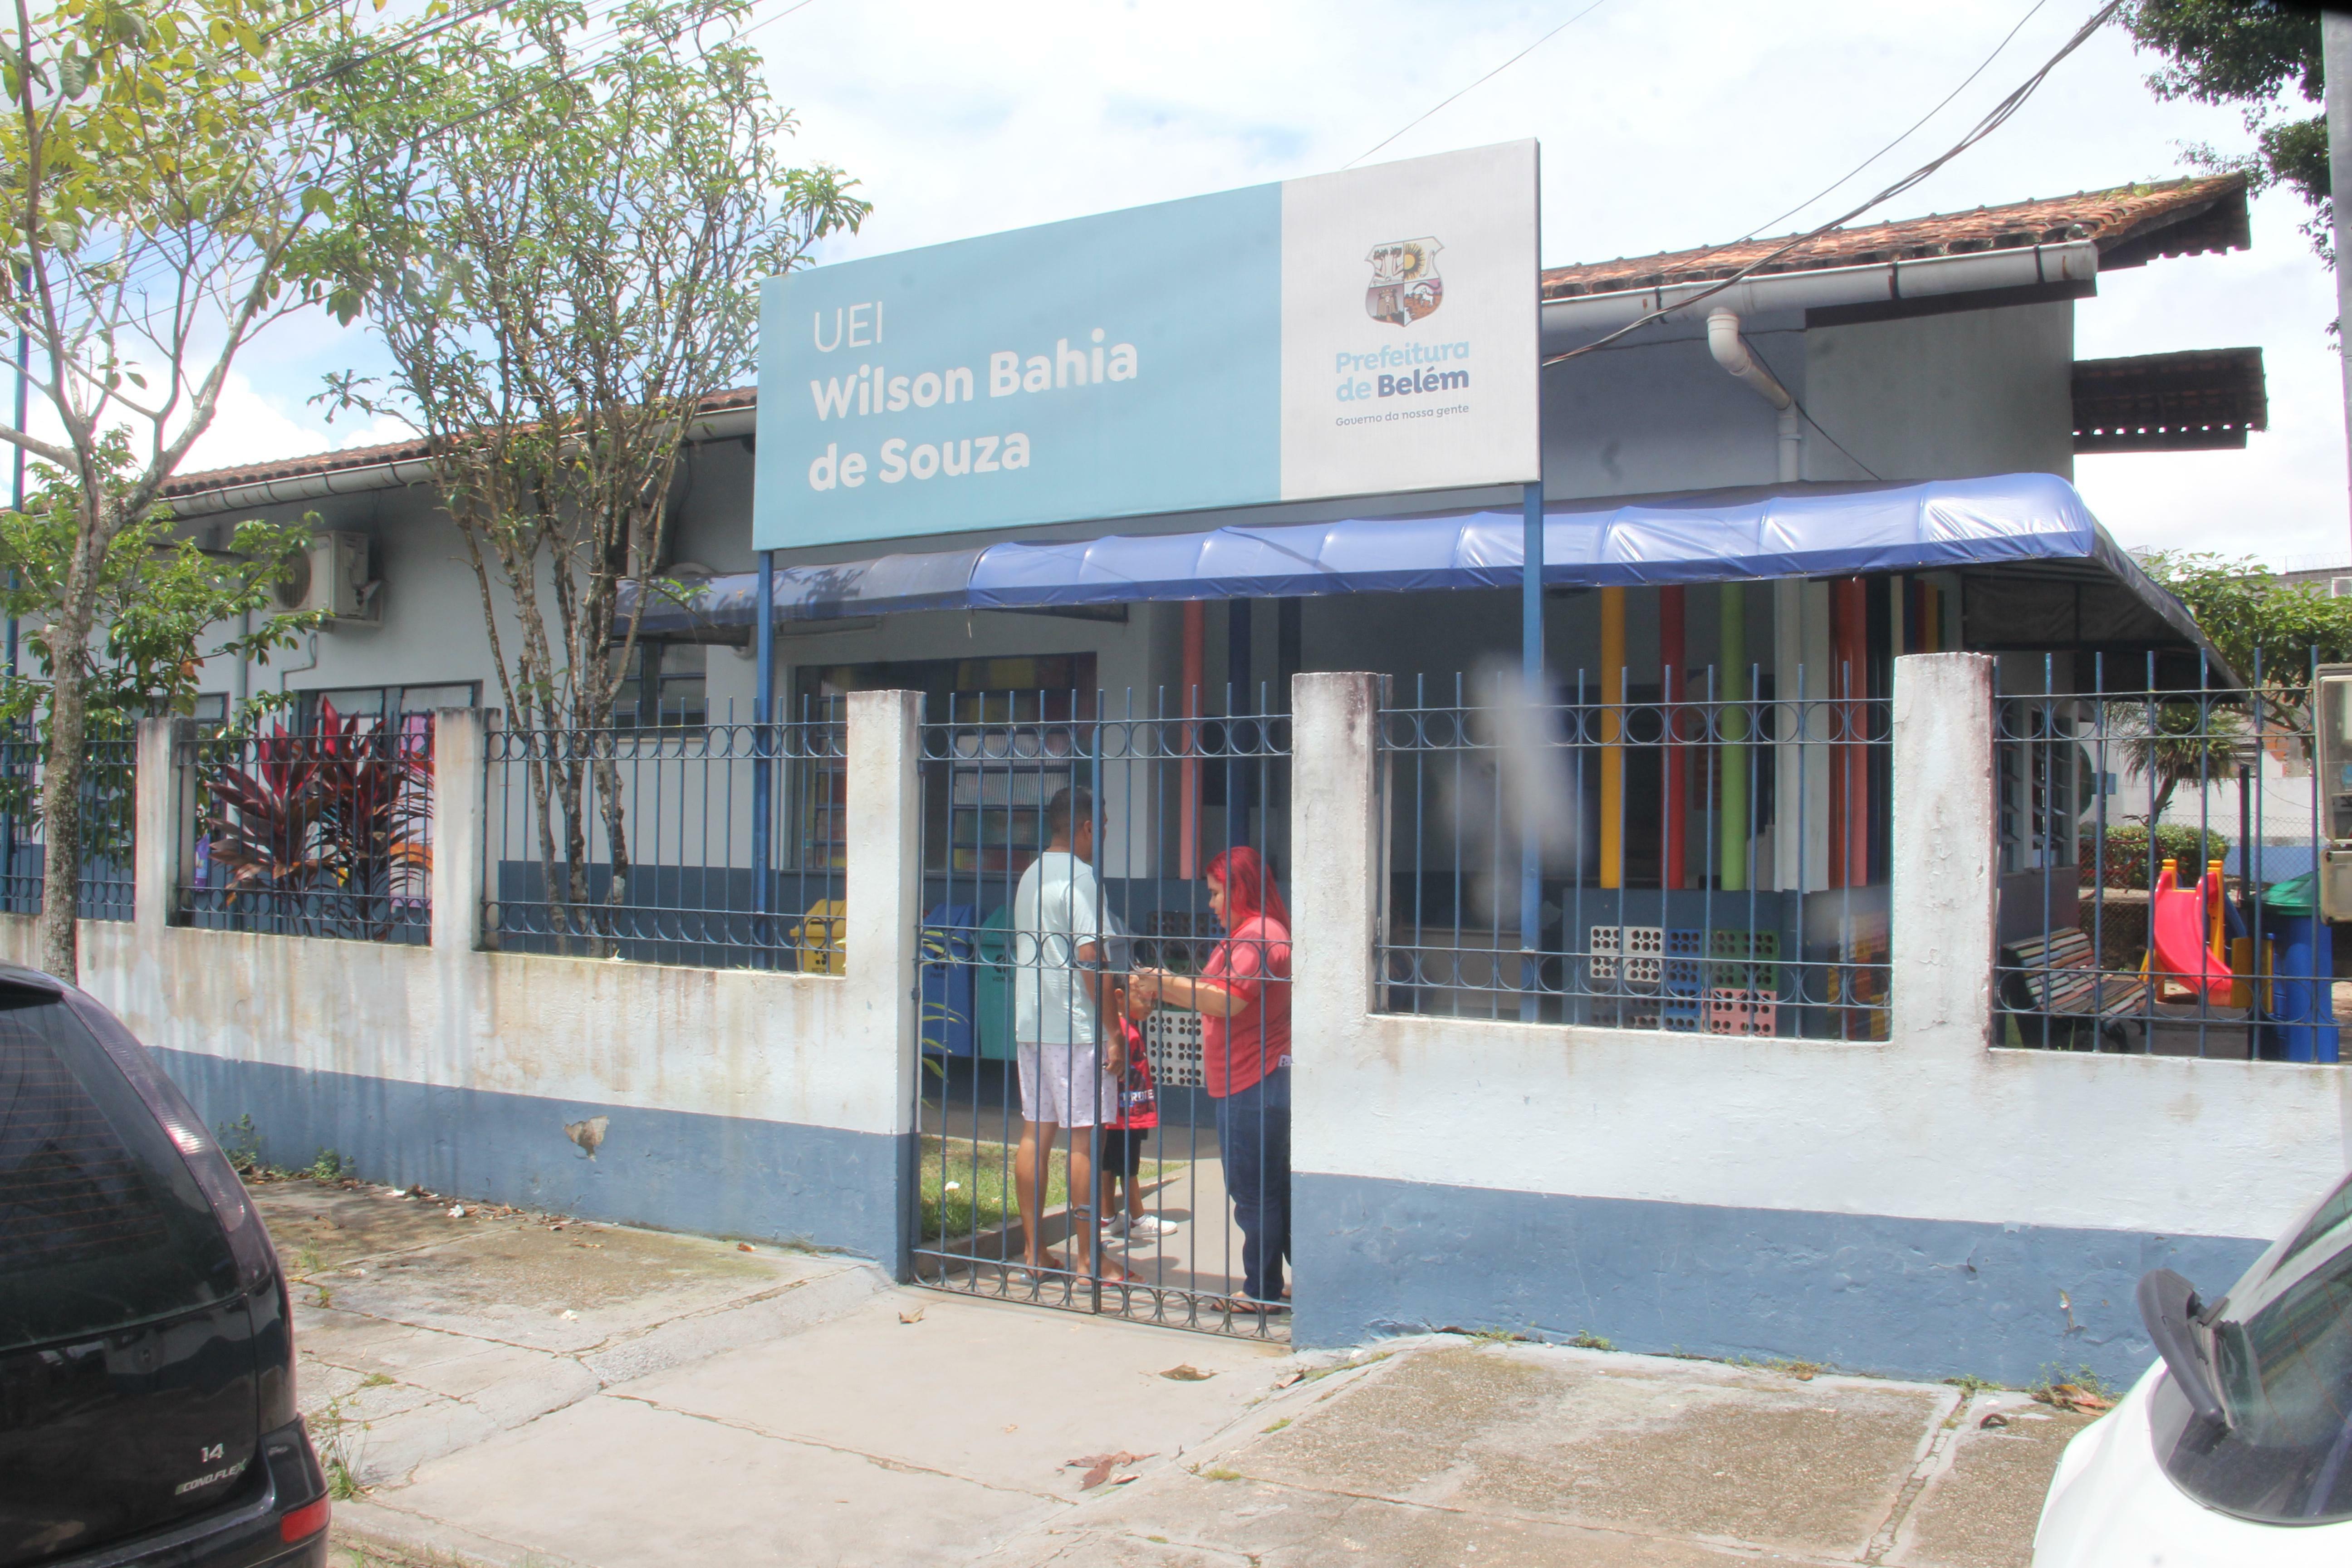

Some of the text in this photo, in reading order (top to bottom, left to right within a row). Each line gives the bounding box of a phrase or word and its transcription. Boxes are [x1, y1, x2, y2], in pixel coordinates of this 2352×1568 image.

[815, 301, 883, 353] UEI
[810, 328, 1137, 421] Wilson Bahia
[1336, 341, 1470, 374] Prefeitura
[1336, 366, 1469, 402] de Belém
[1336, 404, 1470, 426] Governo da nossa gente
[808, 432, 1030, 491] de Souza
